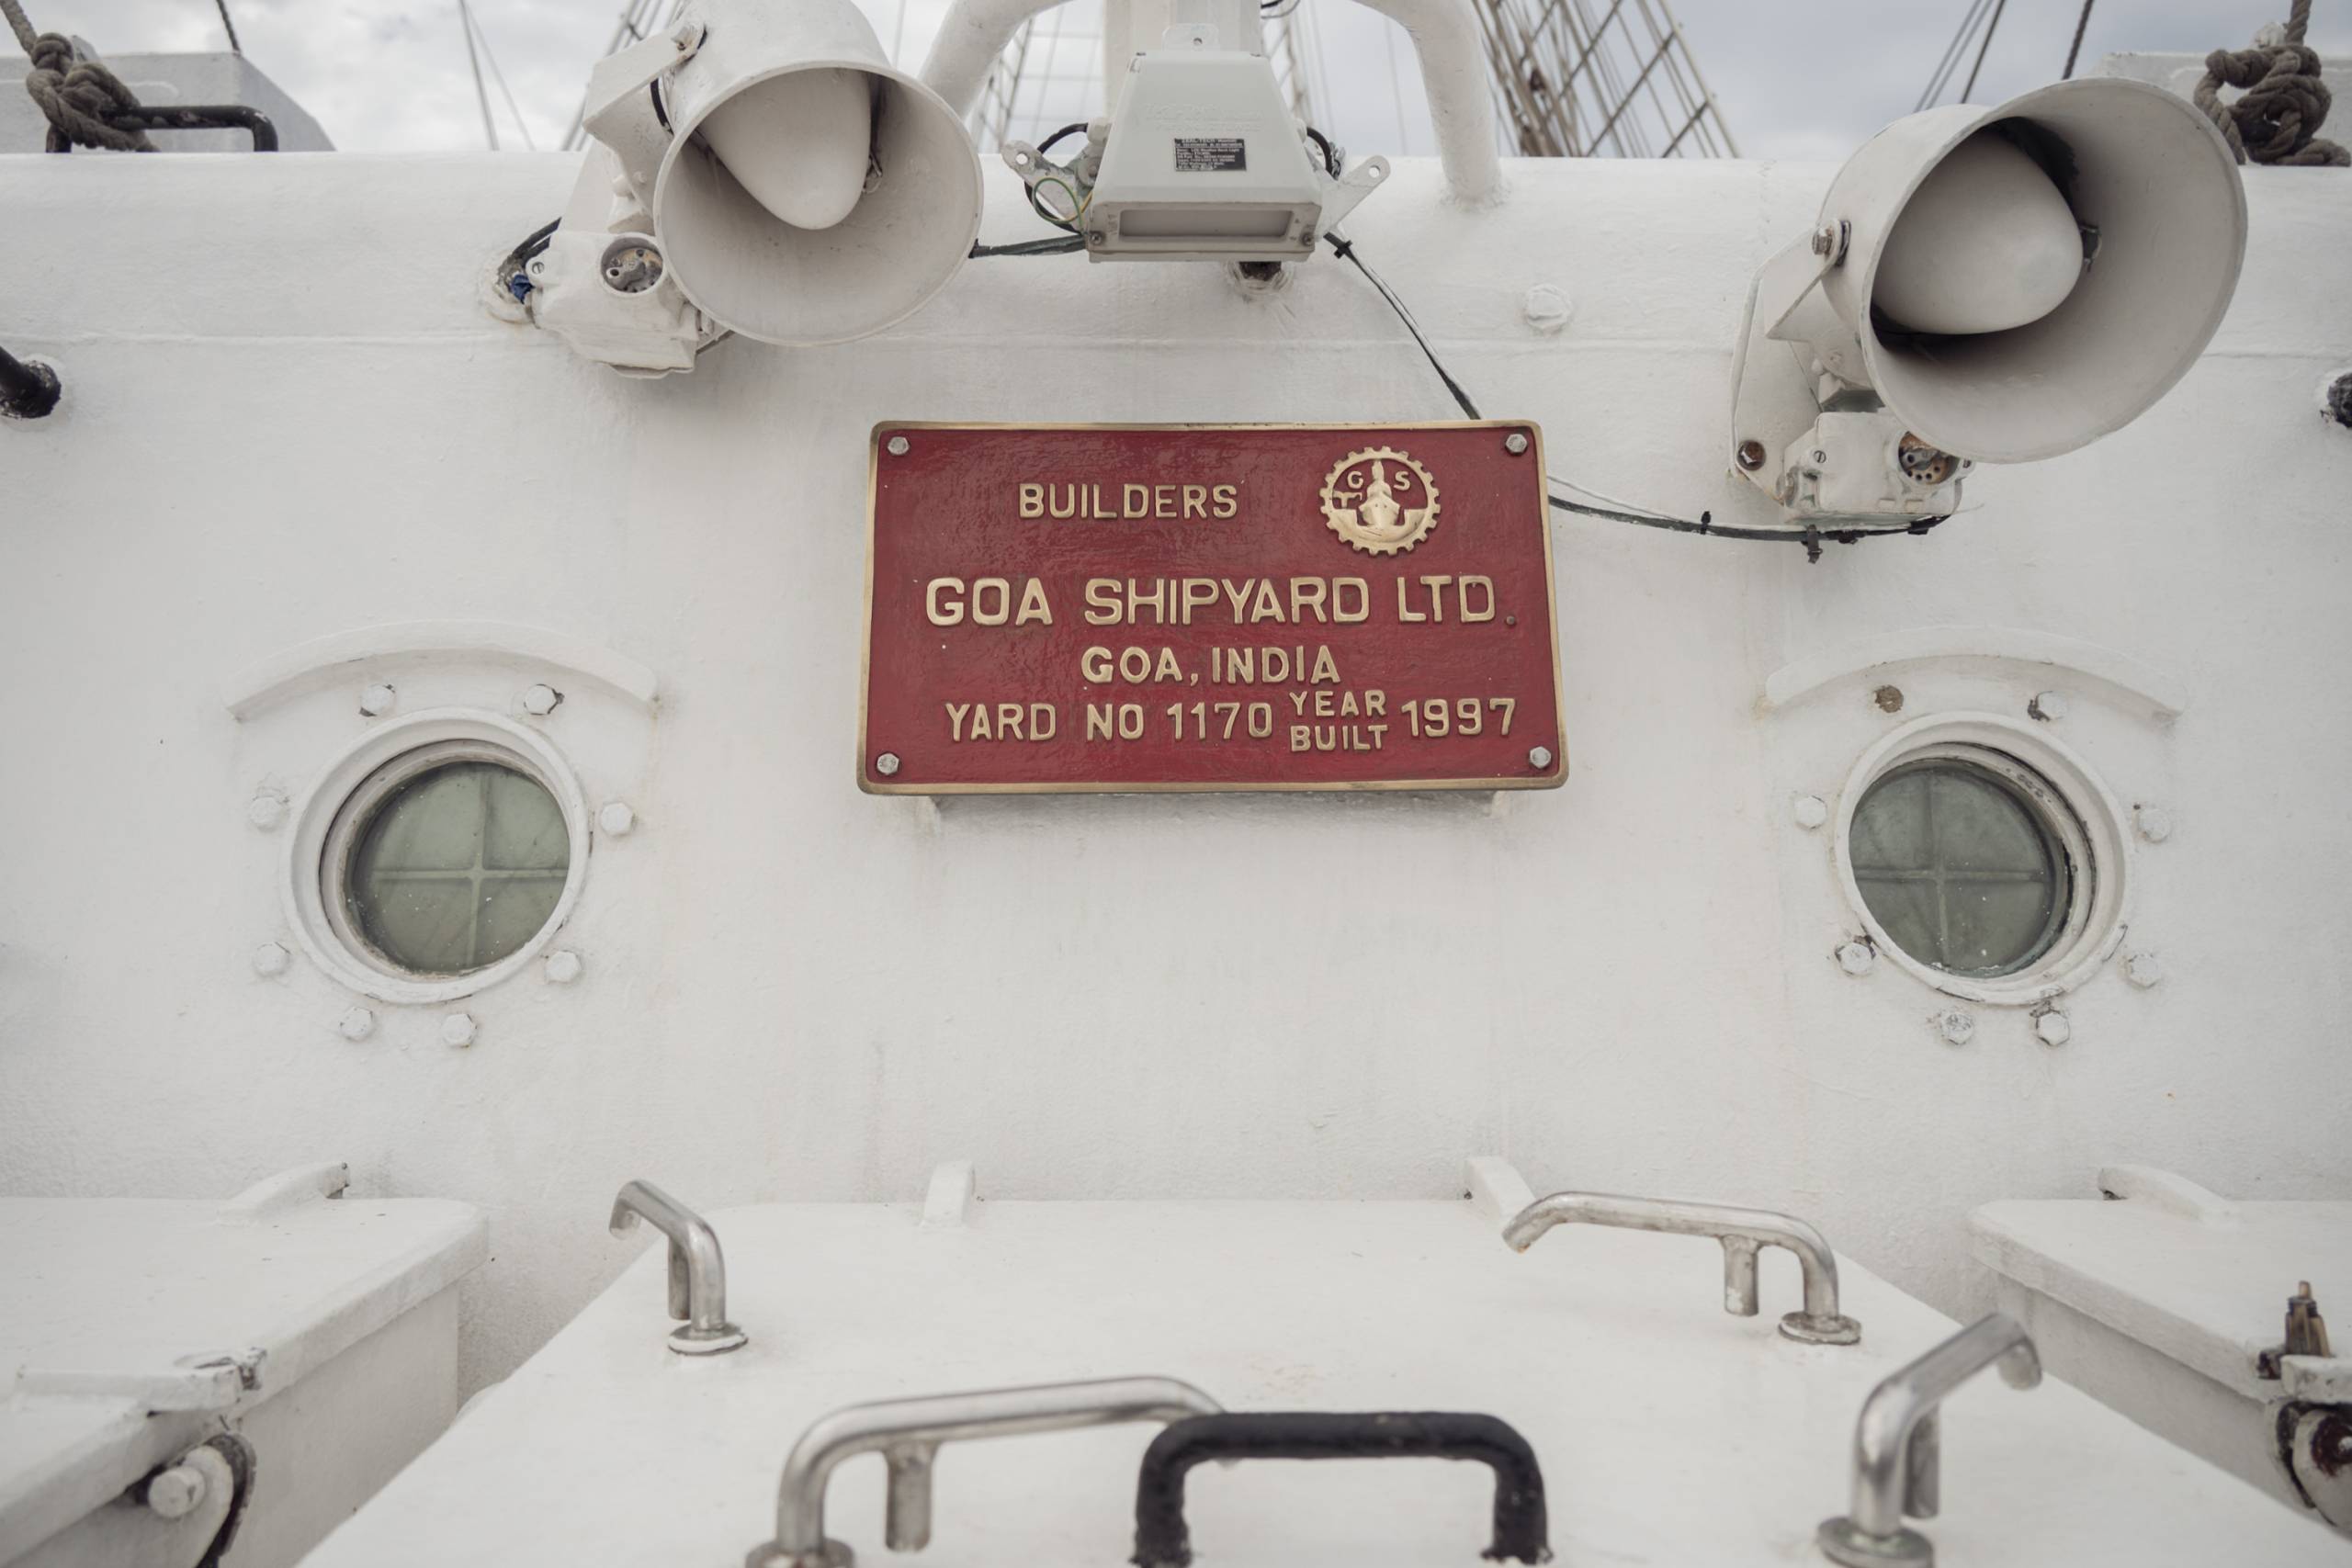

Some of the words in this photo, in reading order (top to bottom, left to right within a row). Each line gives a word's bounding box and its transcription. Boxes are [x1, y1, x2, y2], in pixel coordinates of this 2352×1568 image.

[1019, 482, 1238, 519] BUILDERS
[925, 576, 1054, 626] GOA
[1083, 576, 1369, 626] SHIPYARD
[1080, 646, 1199, 685] GOA,
[1211, 645, 1340, 684] INDIA
[944, 702, 1057, 741] YARD
[1086, 702, 1145, 740] NO
[1167, 701, 1272, 739] 1170
[1289, 690, 1386, 716] YEAR
[1400, 697, 1516, 738] 1997
[1290, 724, 1388, 751] BUILT
